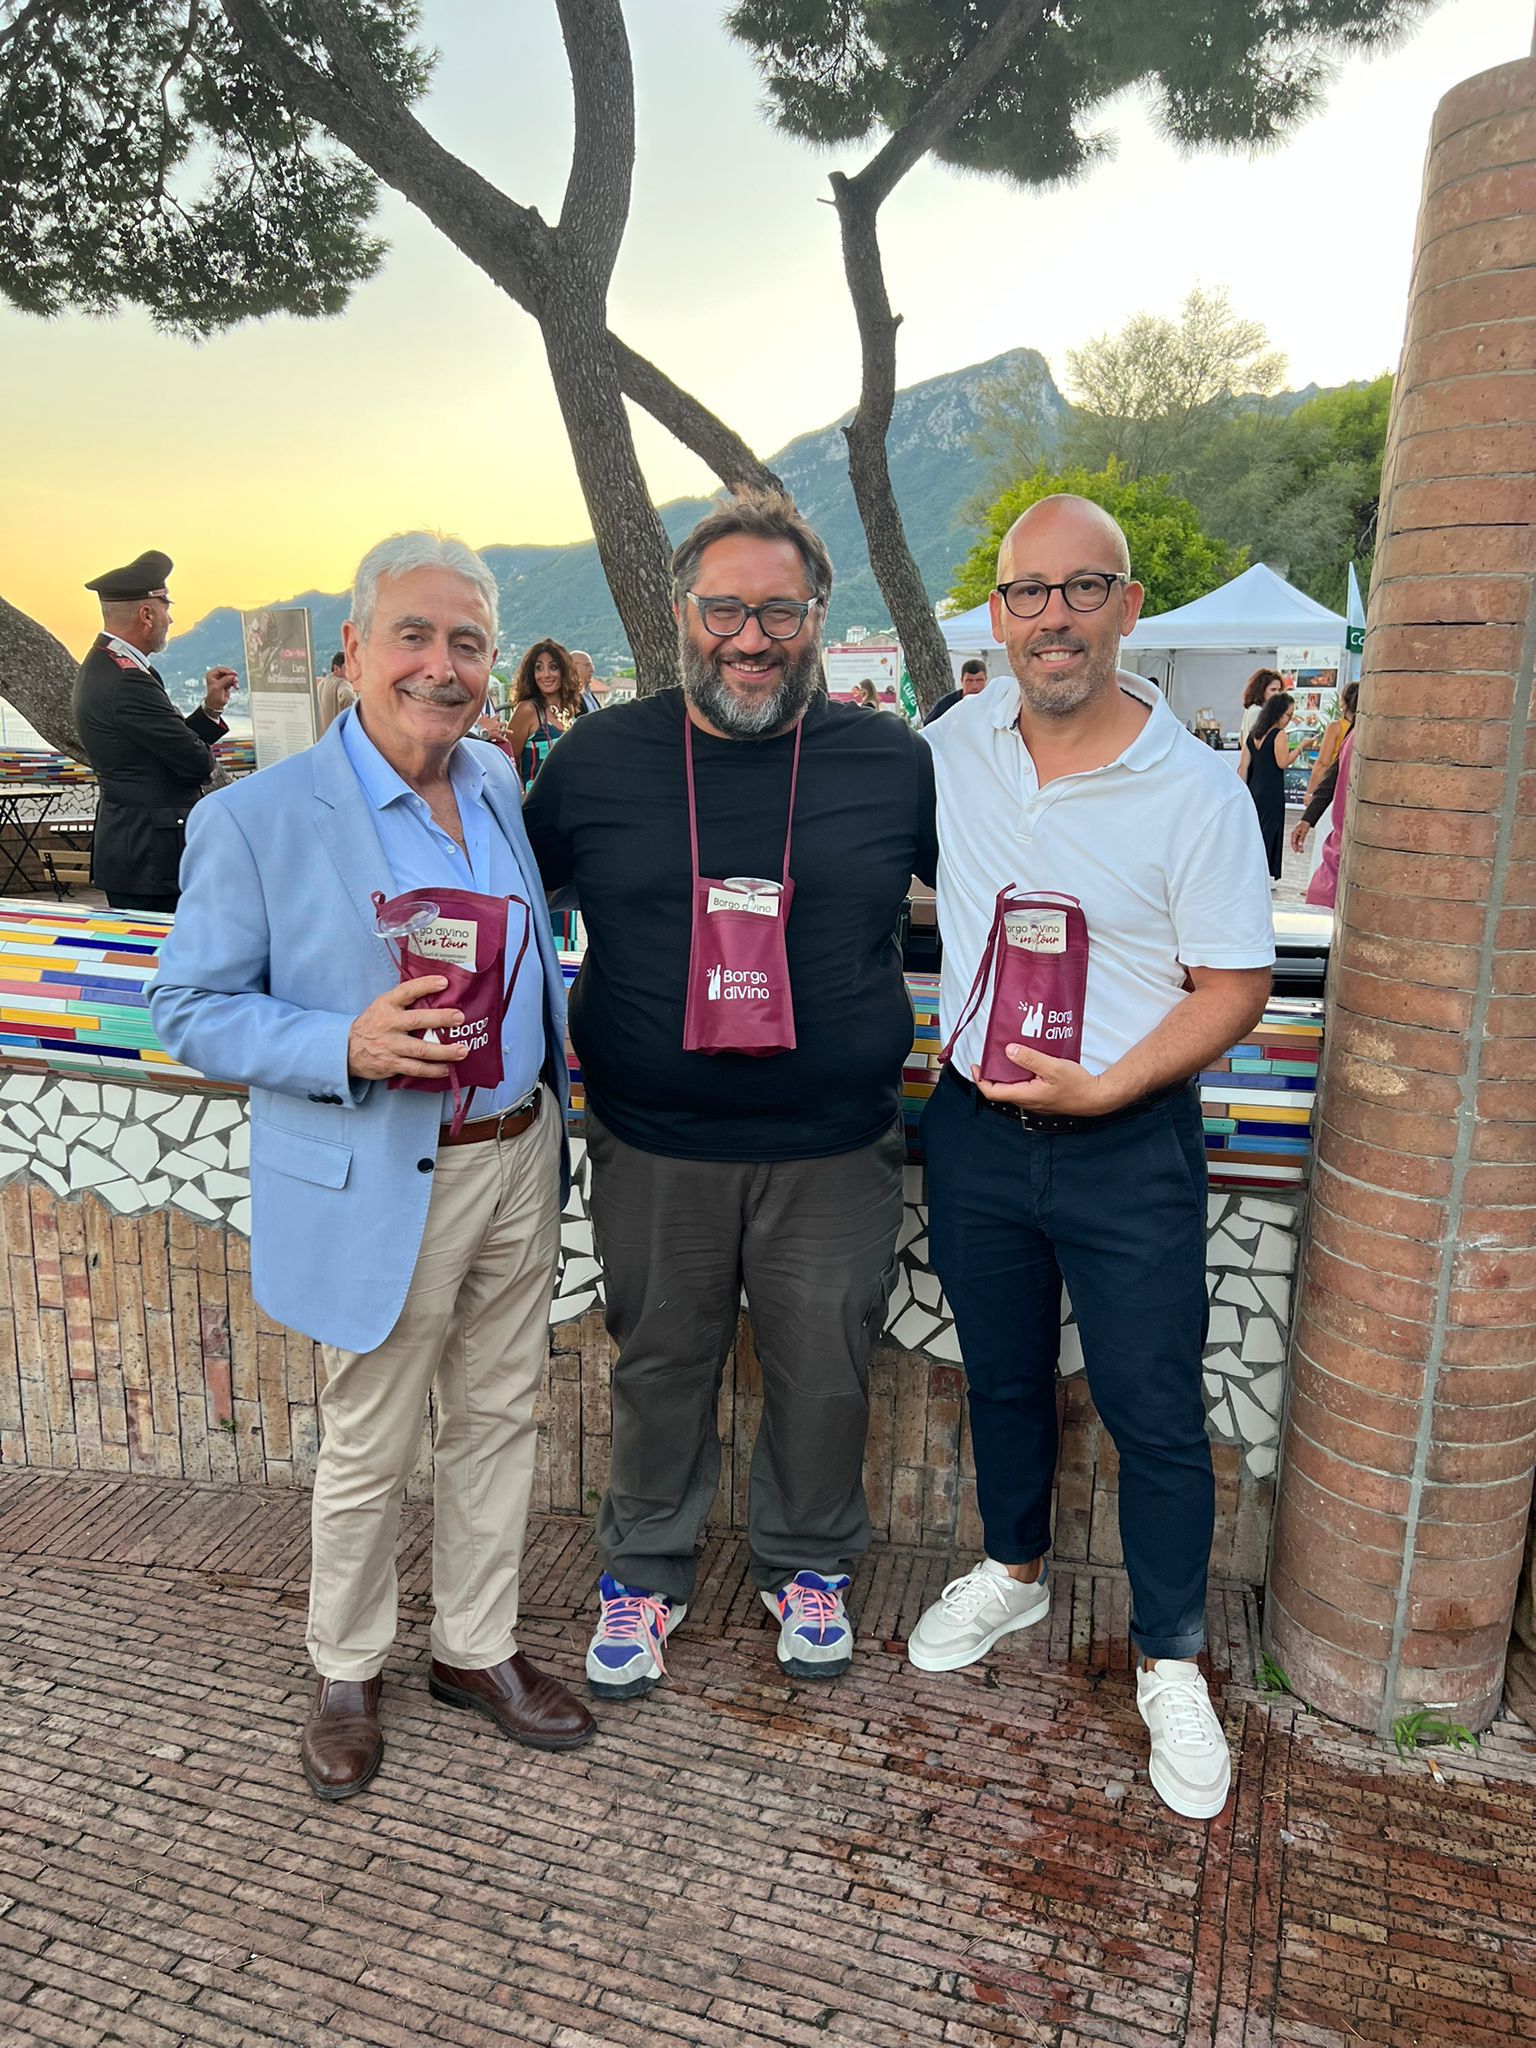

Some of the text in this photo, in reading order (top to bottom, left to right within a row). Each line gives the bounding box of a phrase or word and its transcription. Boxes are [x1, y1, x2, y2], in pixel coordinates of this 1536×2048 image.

[1350, 632, 1365, 646] Co
[713, 897, 740, 910] Borgo
[1006, 925, 1028, 934] orgo
[424, 935, 468, 949] in tour
[723, 969, 768, 985] Borgo
[723, 986, 770, 999] diVino
[449, 1017, 489, 1038] Borgo
